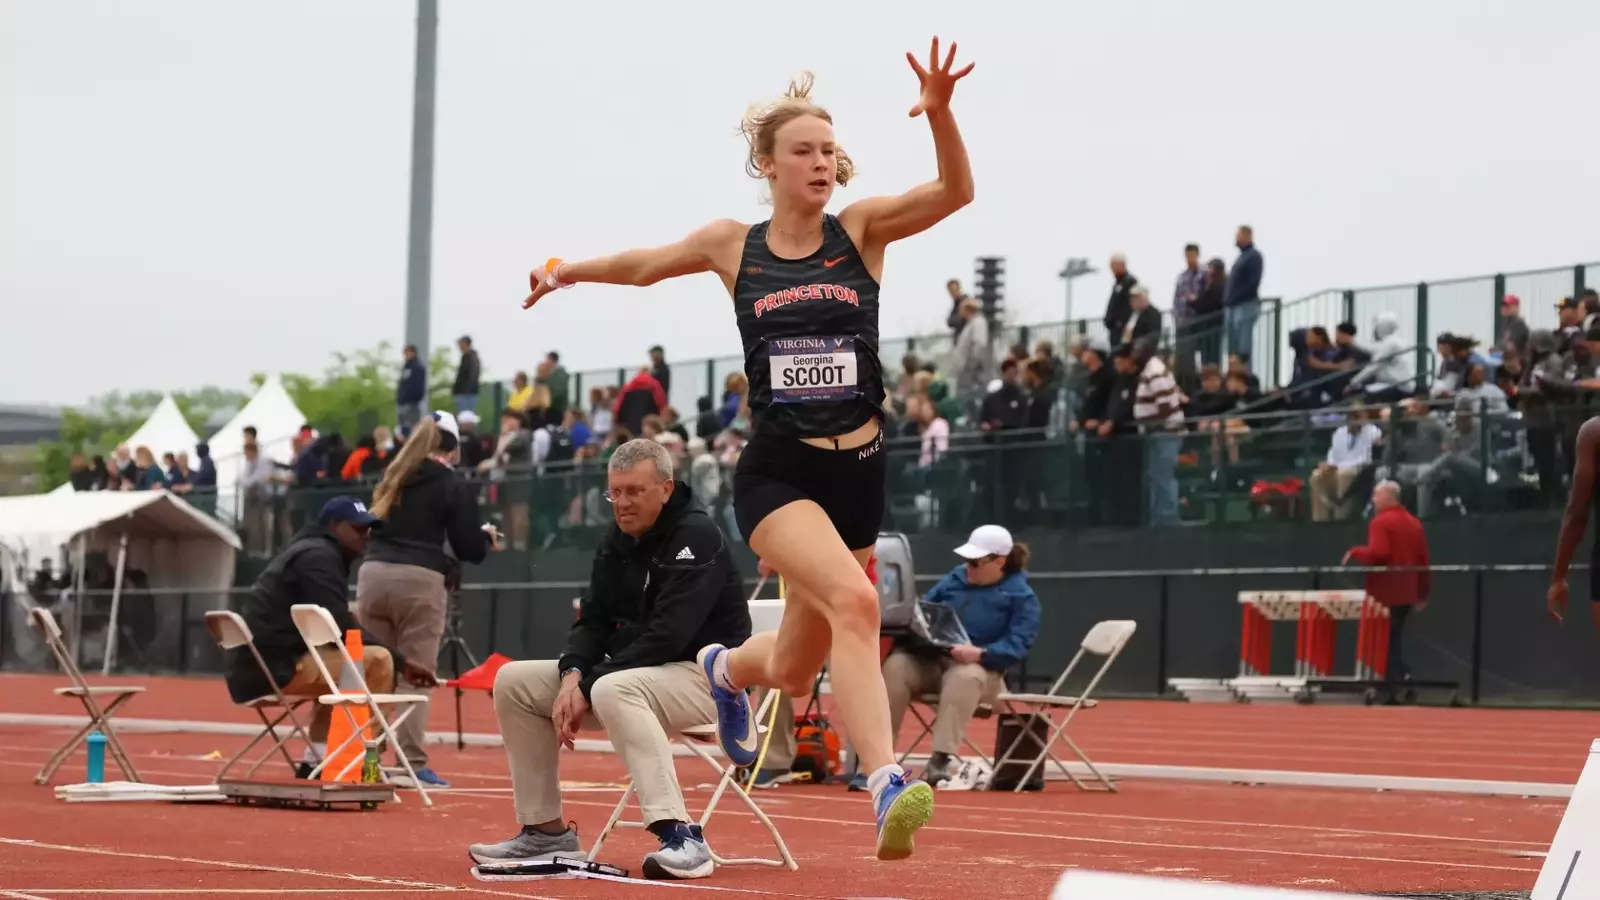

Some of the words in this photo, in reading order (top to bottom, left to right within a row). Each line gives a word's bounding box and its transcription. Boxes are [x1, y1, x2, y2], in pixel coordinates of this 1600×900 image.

[754, 283, 860, 319] PRINCETON
[776, 339, 826, 349] VIRGINIA
[793, 355, 834, 366] Georgina
[782, 365, 846, 387] SCOOT
[858, 440, 880, 461] NIKE
